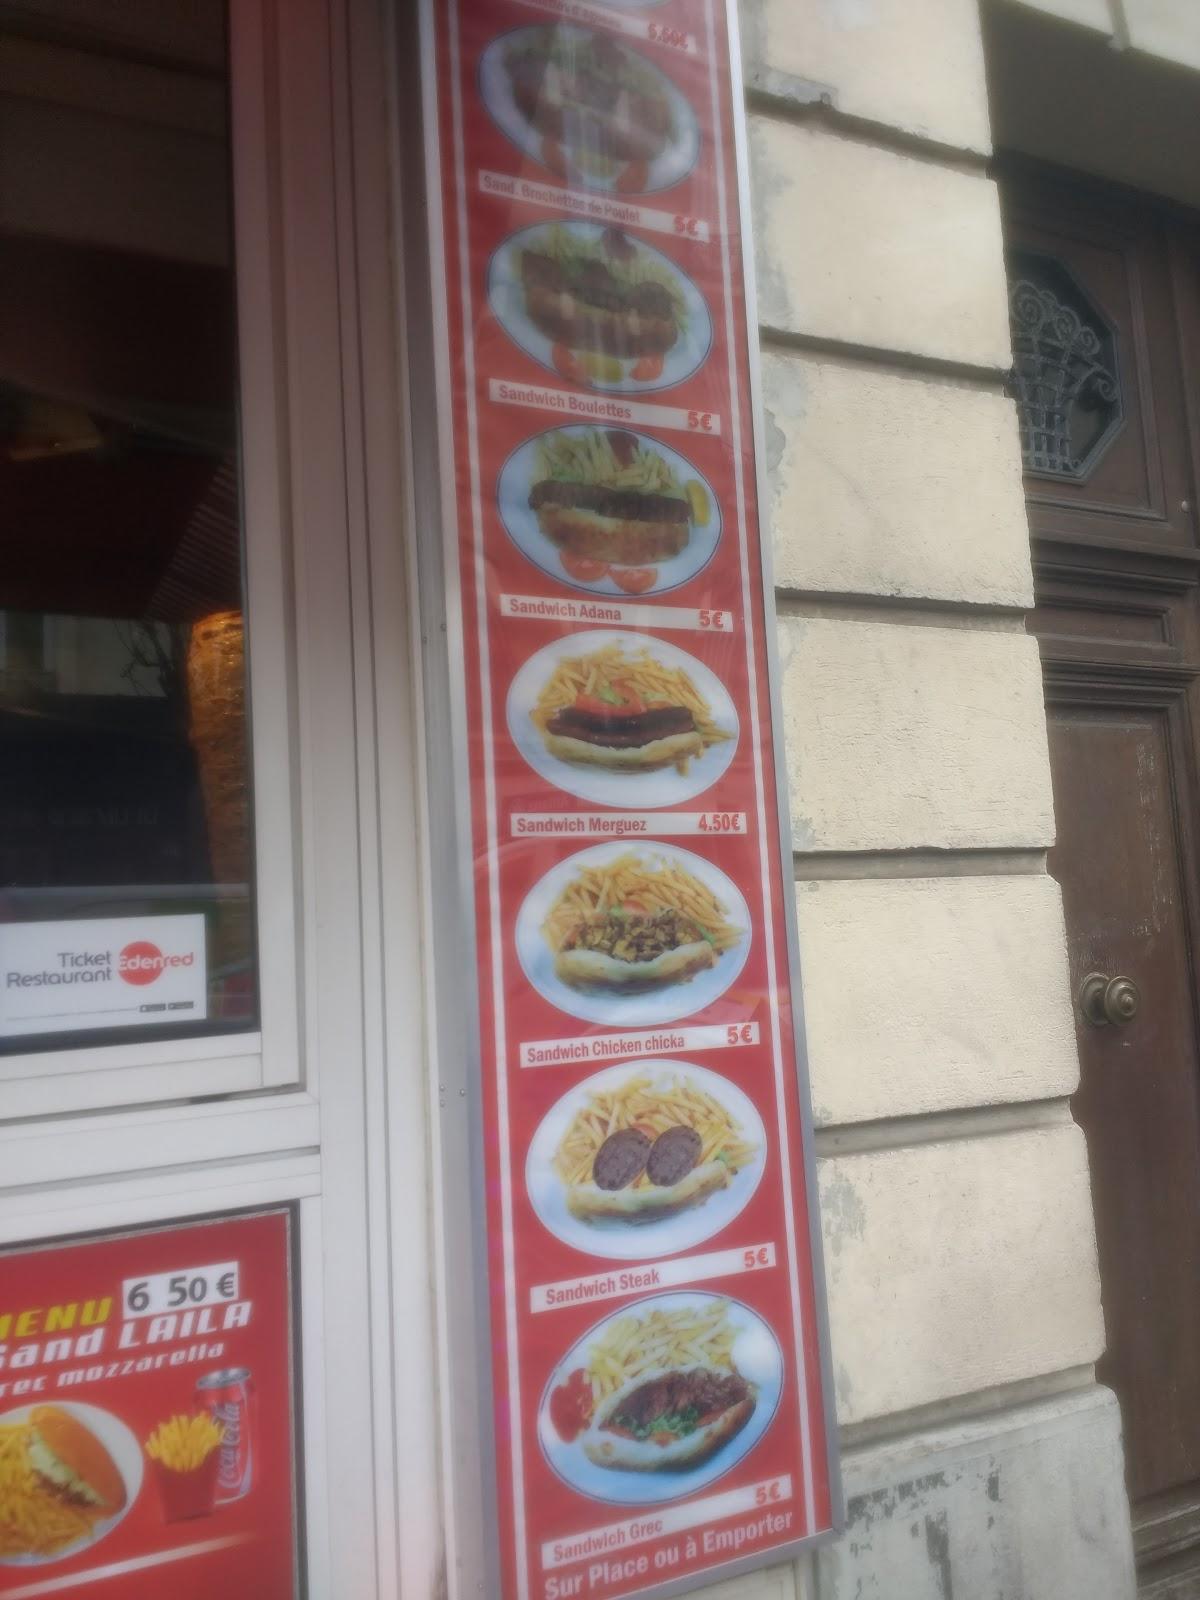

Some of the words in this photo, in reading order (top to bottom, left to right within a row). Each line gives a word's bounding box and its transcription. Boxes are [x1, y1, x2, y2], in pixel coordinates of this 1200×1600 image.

[500, 385, 565, 408] Sandwich
[569, 397, 631, 419] Boulettes
[687, 410, 713, 431] 5€
[510, 599, 576, 617] Sandwich
[580, 607, 621, 621] Adana
[700, 610, 724, 628] 5€
[517, 817, 585, 833] Sandwich
[589, 818, 647, 835] Merguez
[699, 813, 740, 831] 4.50€
[6, 967, 112, 988] Restaurant
[57, 950, 112, 968] Ticket
[119, 952, 194, 972] Edenred
[527, 1043, 589, 1063] Sandwich
[592, 1039, 642, 1056] Chicken
[645, 1034, 685, 1051] chicka
[727, 1024, 753, 1044] 5€
[546, 1277, 616, 1305] Sandwich
[619, 1269, 661, 1291] Steak
[744, 1247, 769, 1268] 5€
[118, 1301, 251, 1349] LAILA
[57, 1343, 224, 1388] mozzarella
[553, 1528, 626, 1563] Sandwich
[629, 1519, 664, 1540] Grec
[756, 1482, 781, 1505] 5€
[544, 1574, 584, 1600] Sur
[588, 1556, 649, 1589] Place
[654, 1550, 679, 1569] ou
[685, 1536, 698, 1559] à
[703, 1510, 793, 1554] Emporter
